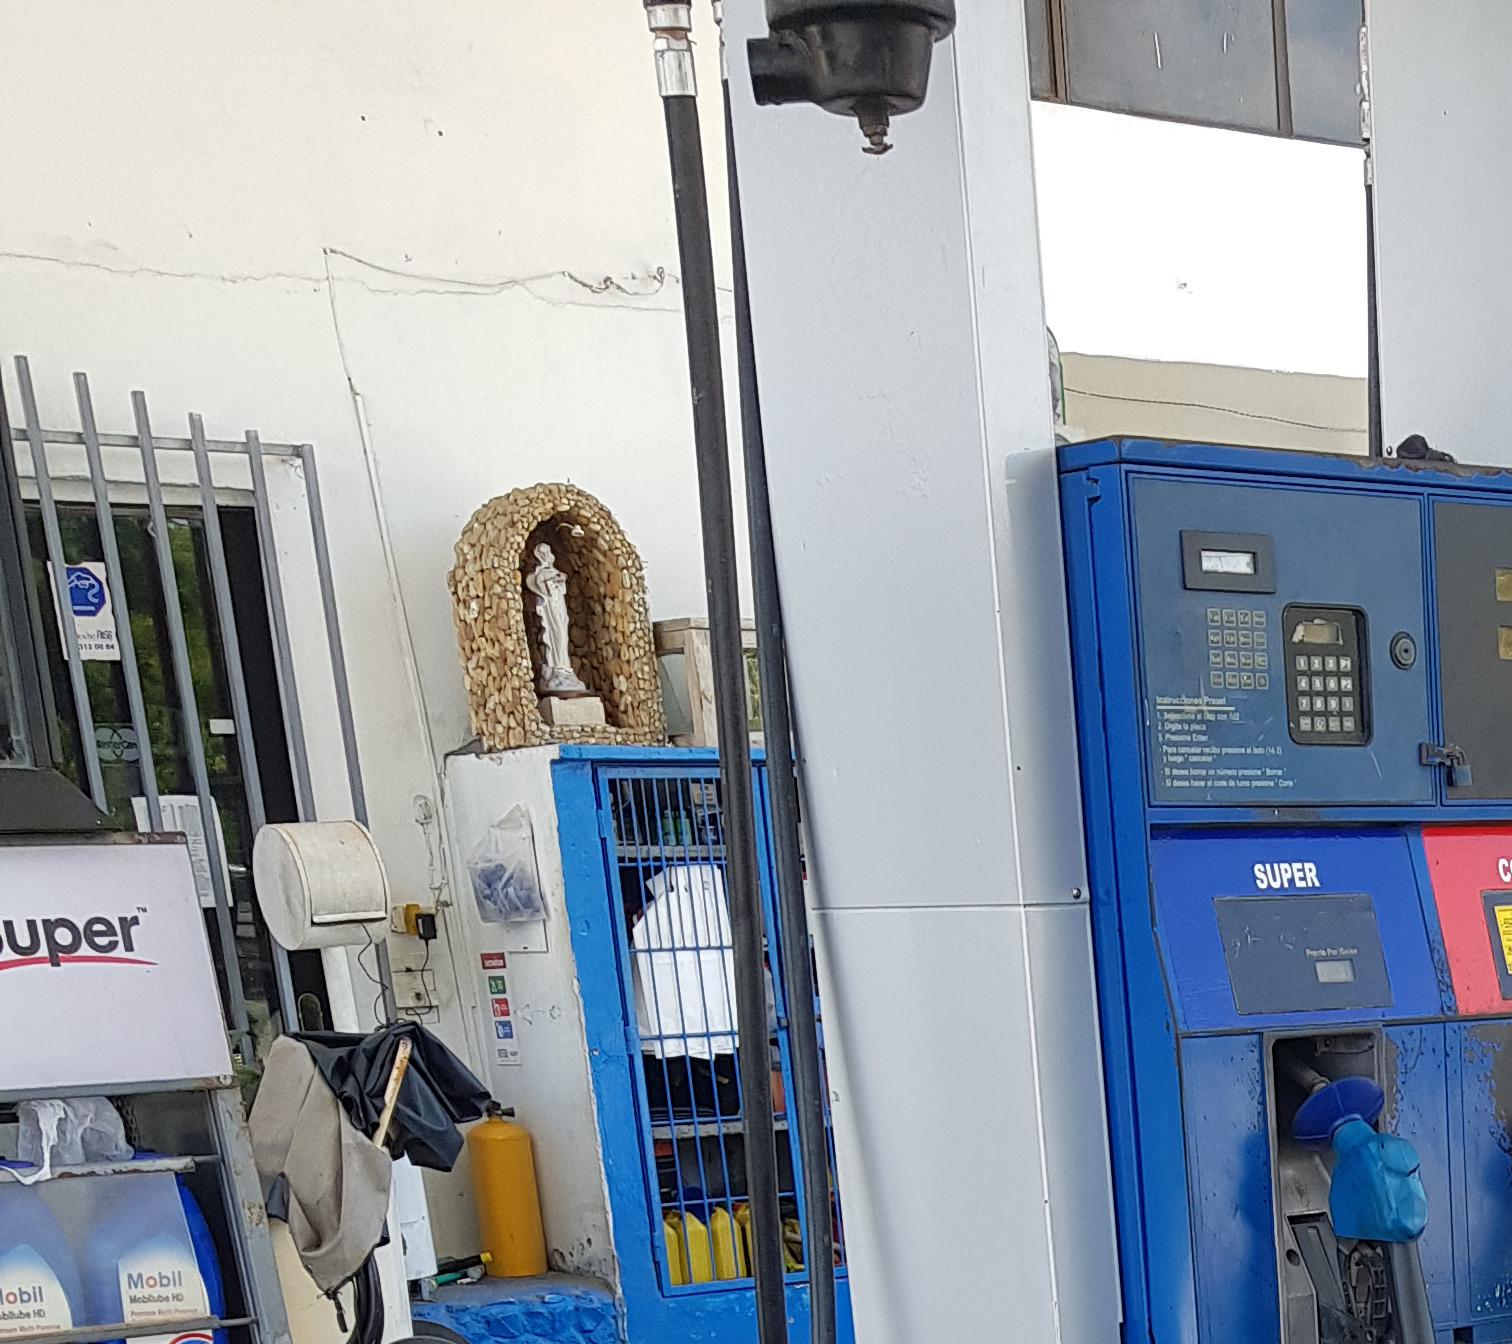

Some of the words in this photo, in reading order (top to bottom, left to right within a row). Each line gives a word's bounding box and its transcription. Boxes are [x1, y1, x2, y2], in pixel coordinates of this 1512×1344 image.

[1254, 862, 1321, 889] SUPER
[0, 915, 140, 967] uper
[128, 1270, 183, 1290] Mobil
